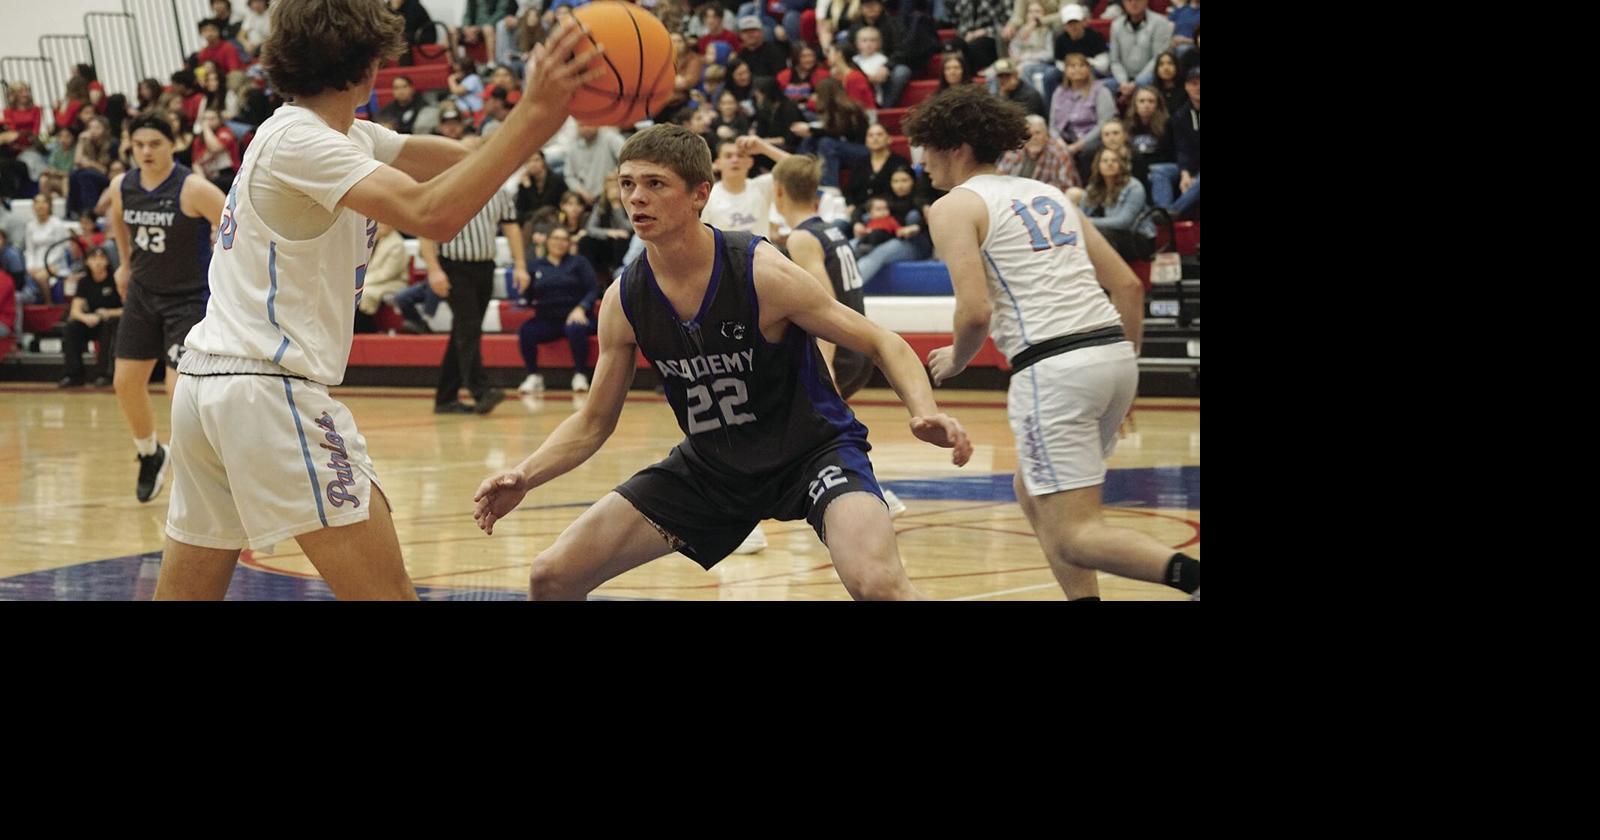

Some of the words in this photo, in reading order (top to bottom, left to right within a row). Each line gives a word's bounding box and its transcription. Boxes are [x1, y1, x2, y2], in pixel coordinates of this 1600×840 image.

[134, 226, 166, 253] 43
[1010, 195, 1077, 252] 12
[655, 348, 754, 382] ACADEMY
[686, 377, 758, 434] 22
[808, 465, 849, 505] 22
